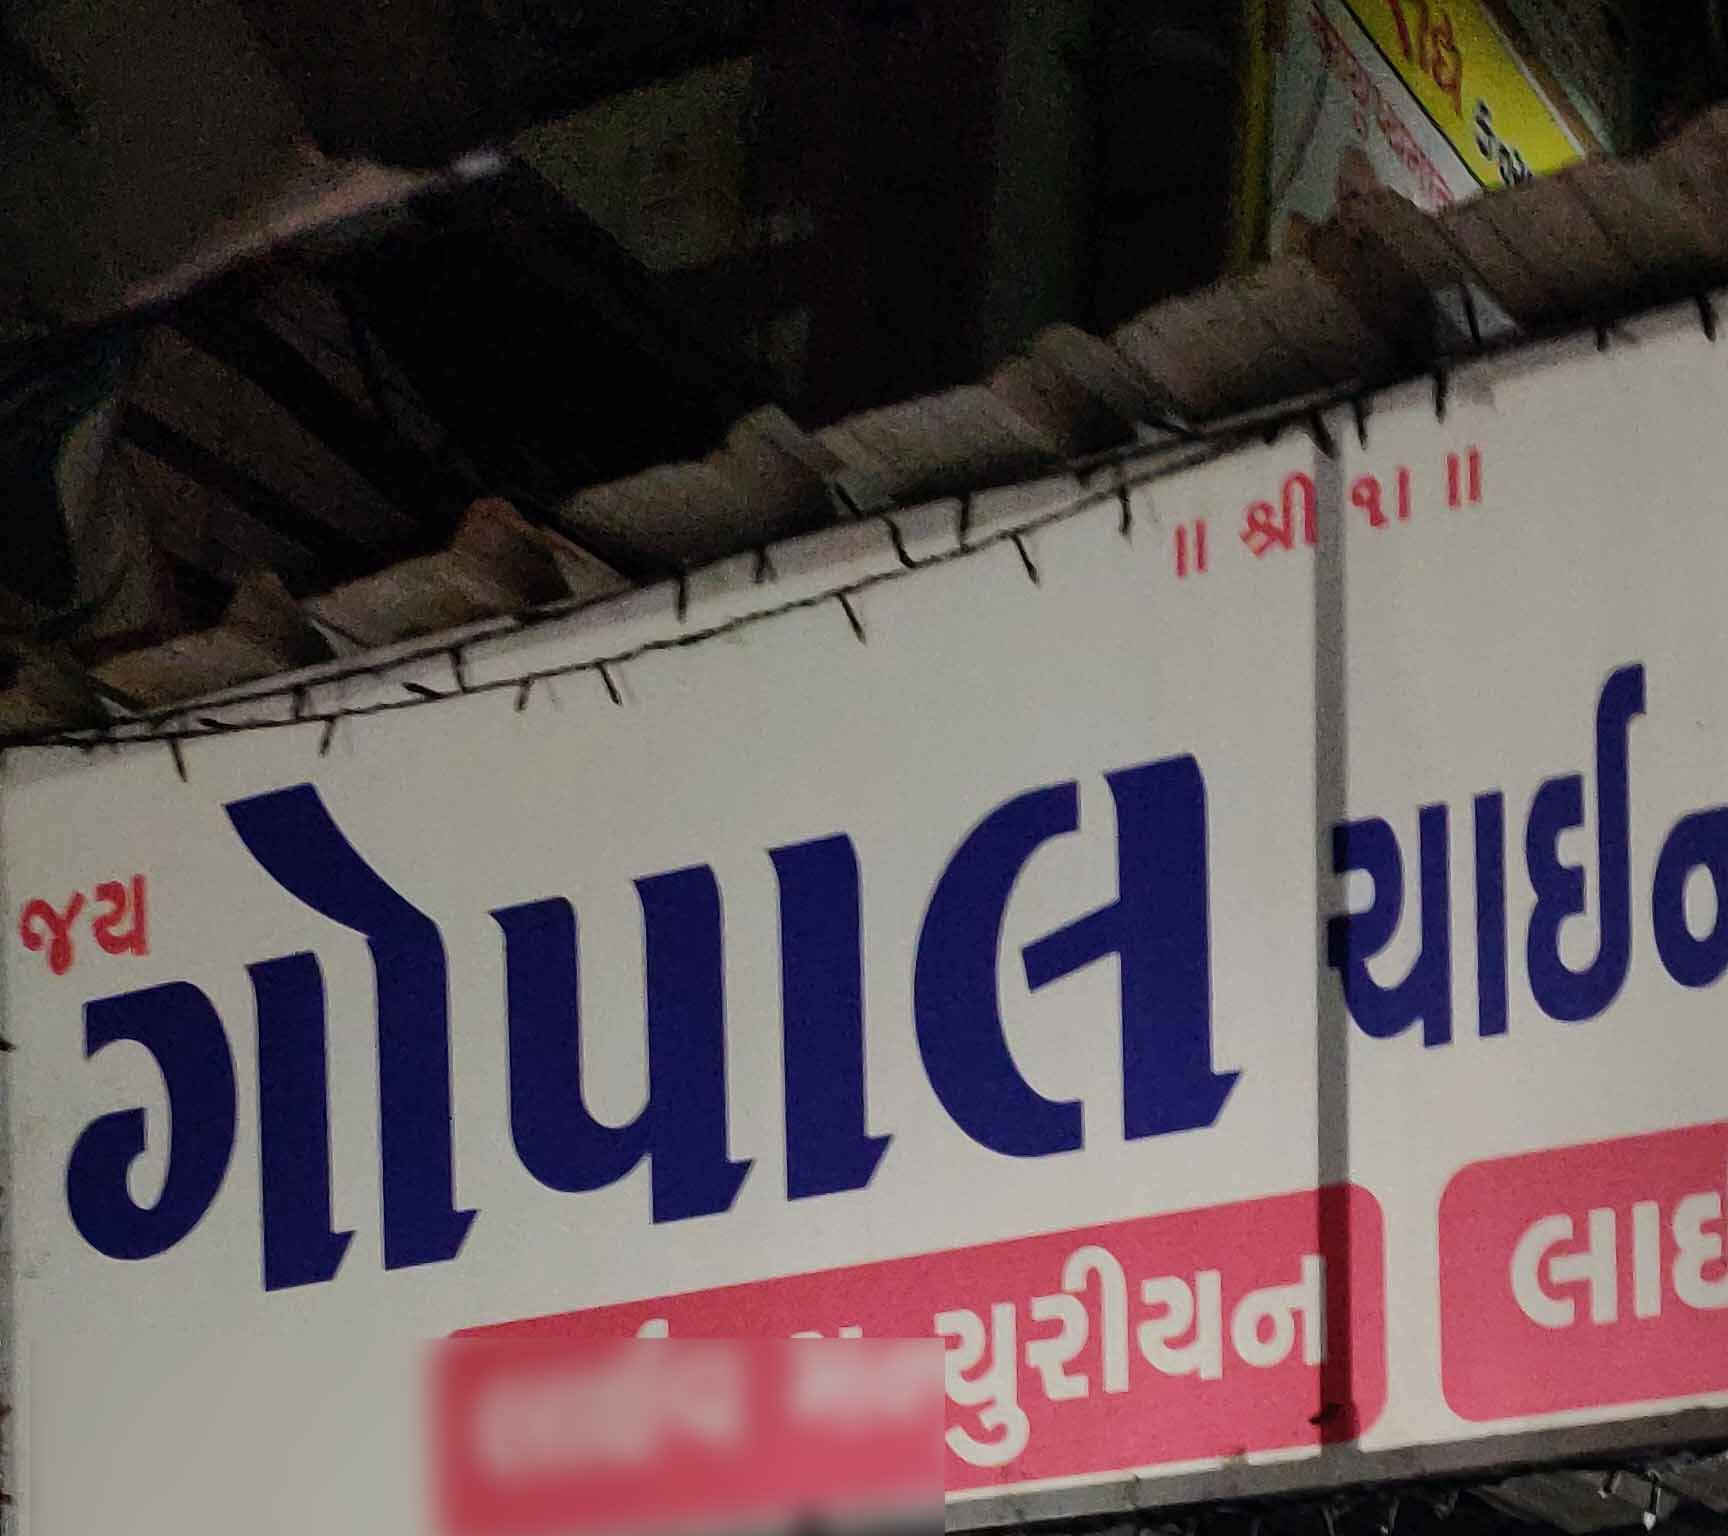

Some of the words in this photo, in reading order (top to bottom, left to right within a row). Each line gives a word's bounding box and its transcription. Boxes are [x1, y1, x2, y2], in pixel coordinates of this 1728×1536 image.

[1239, 471, 1318, 558] શ્રી
[20, 873, 149, 976] જય
[66, 754, 1242, 1293] ગોપાલ
